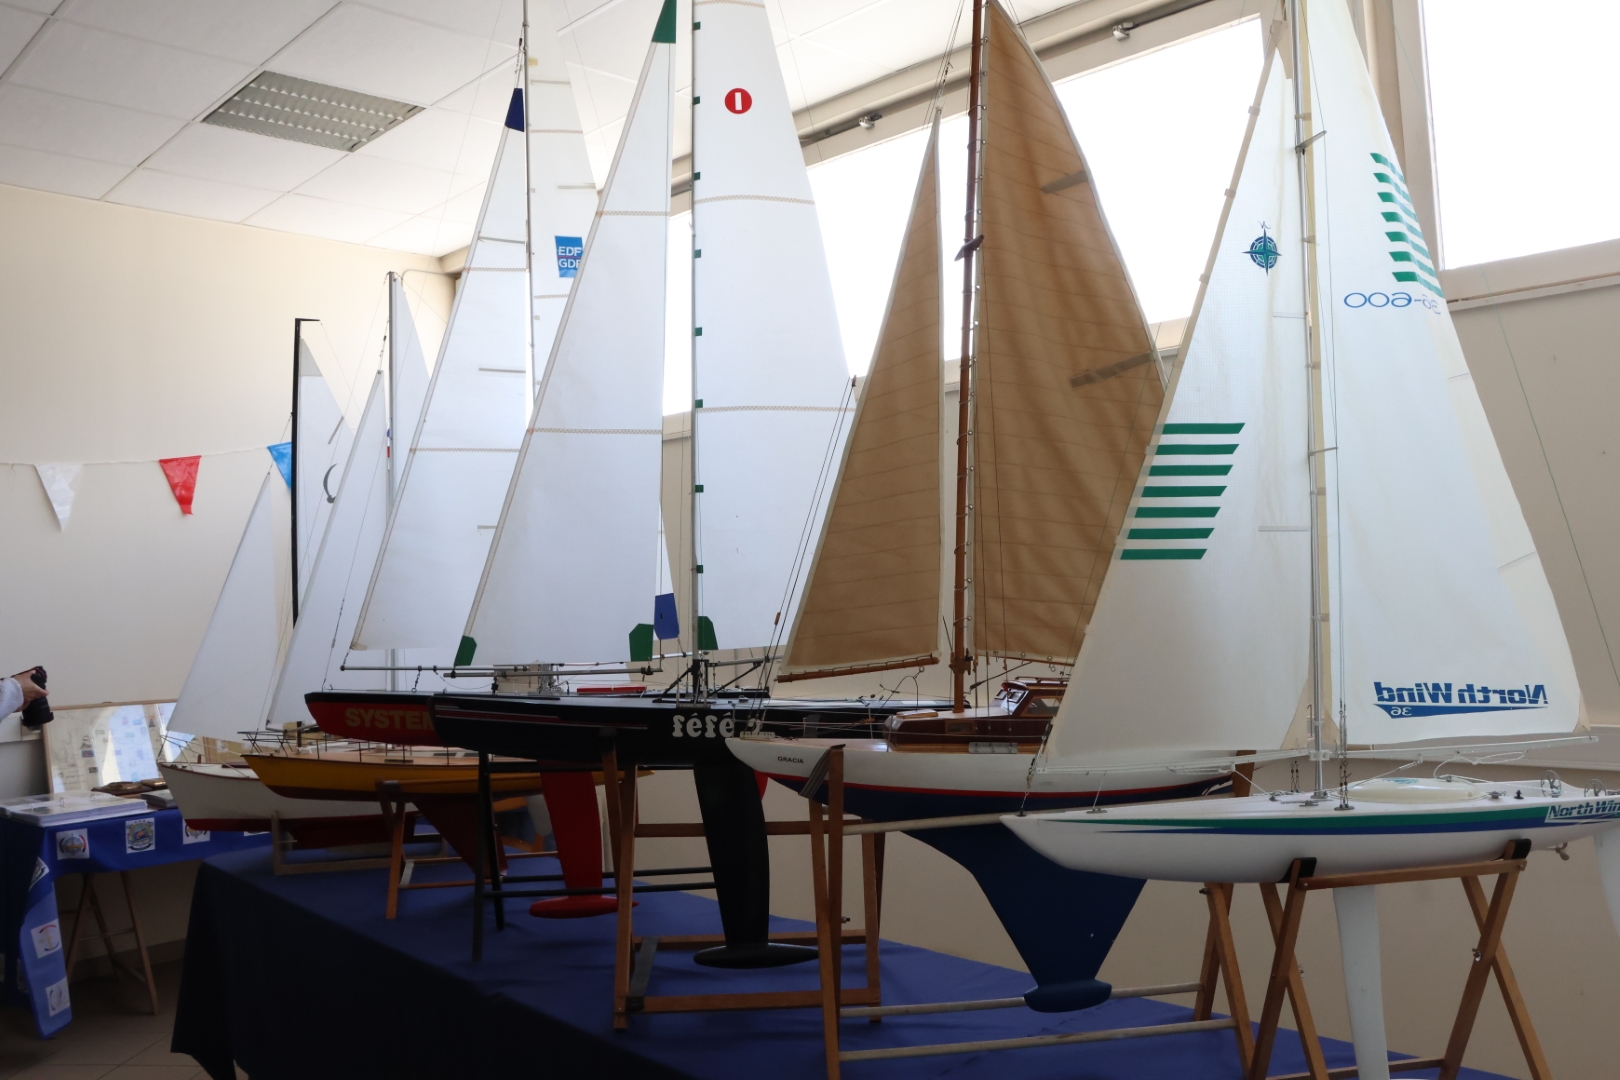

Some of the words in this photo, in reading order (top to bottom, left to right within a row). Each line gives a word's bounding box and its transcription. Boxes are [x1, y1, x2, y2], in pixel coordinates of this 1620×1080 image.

[558, 246, 582, 257] EDF
[672, 712, 735, 738] féfé
[777, 755, 804, 764] GRACIA
[1548, 802, 1594, 818] North
